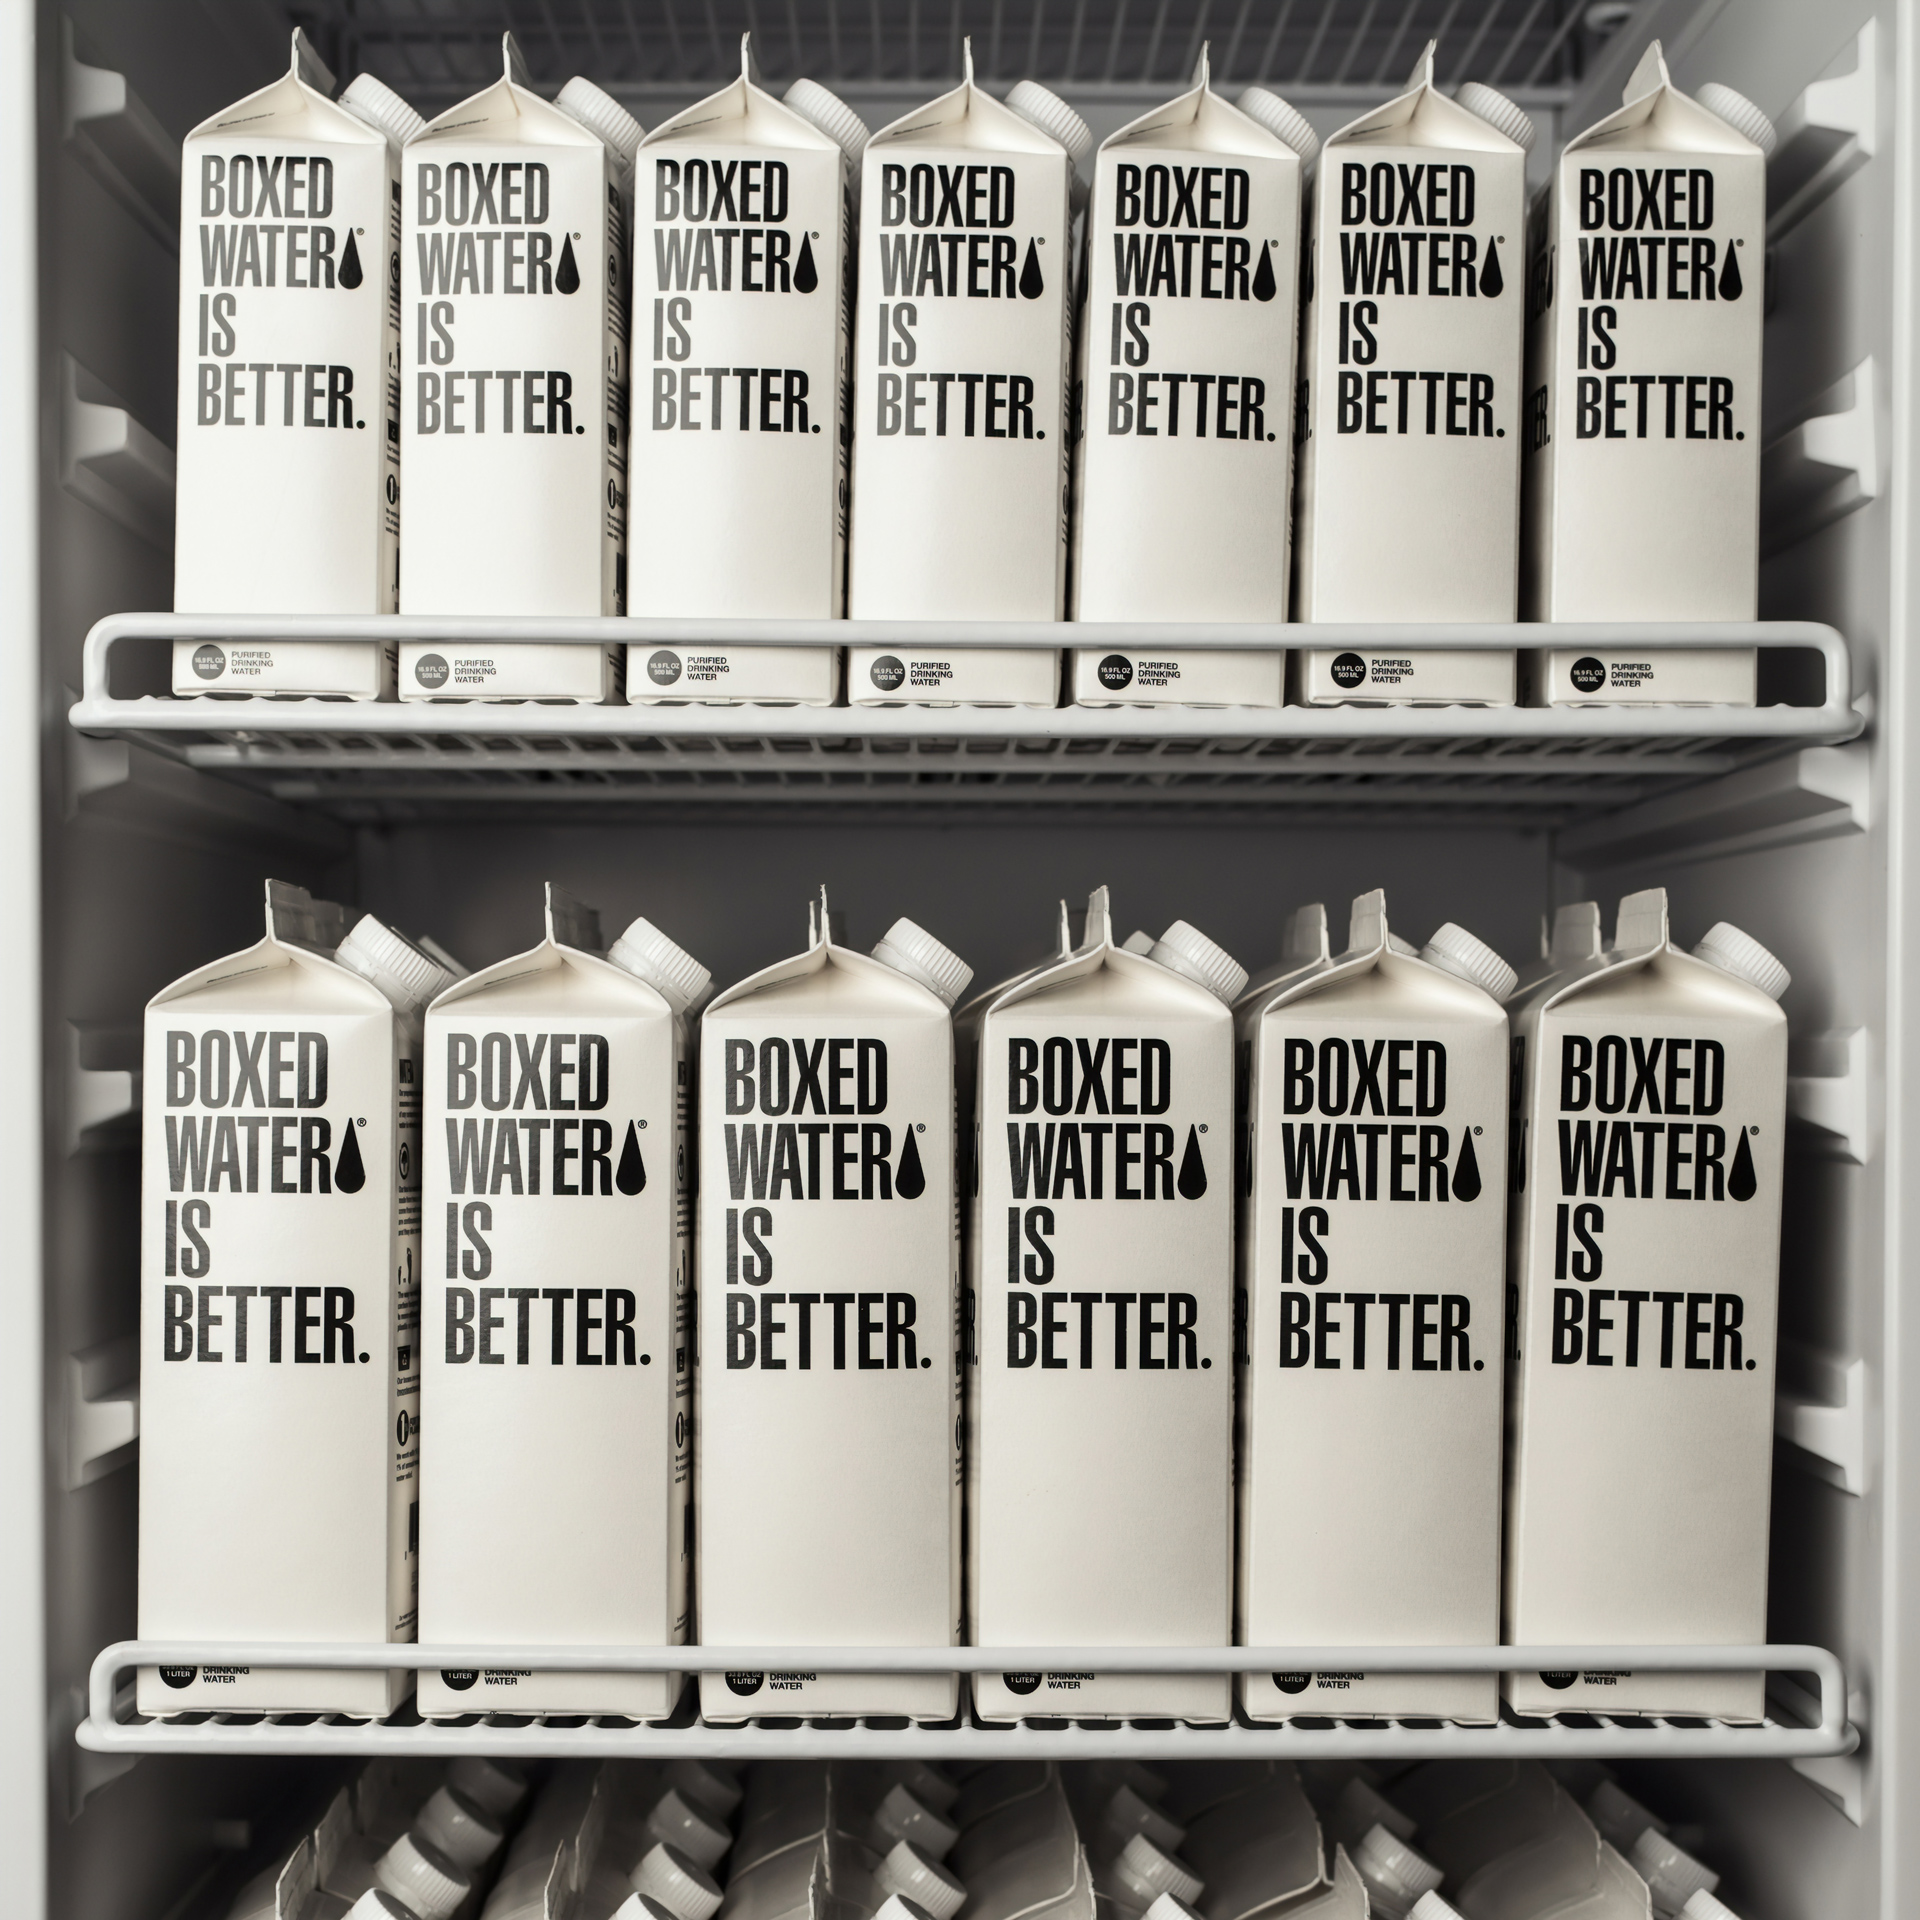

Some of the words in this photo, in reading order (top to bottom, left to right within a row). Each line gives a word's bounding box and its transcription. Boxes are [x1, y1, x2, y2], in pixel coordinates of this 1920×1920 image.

[202, 154, 333, 218] BOXED
[418, 162, 549, 225] BOXED
[656, 159, 788, 223] BOXED
[882, 163, 1015, 228] BOXED
[1116, 164, 1250, 230] BOXED
[1341, 162, 1475, 227] BOXED
[1579, 167, 1714, 232] BOXED
[200, 225, 335, 289] WATER
[417, 232, 553, 295] WATER
[654, 229, 791, 293] WATER
[880, 234, 1017, 299] WATER
[1114, 233, 1251, 301] WATER
[1340, 232, 1477, 298] WATER
[1578, 236, 1717, 301] WATER
[199, 293, 236, 357] IS
[418, 301, 454, 365] IS
[654, 297, 691, 361] IS
[879, 303, 917, 367] IS
[1111, 302, 1150, 367] IS
[1339, 300, 1378, 365] IS
[1578, 305, 1617, 371] IS
[198, 364, 365, 429] BETTER.
[418, 371, 585, 435] BETTER.
[653, 368, 821, 434] BETTER.
[877, 373, 1045, 440] BETTER.
[1108, 373, 1276, 442] BETTER.
[1337, 371, 1506, 438] BETTER.
[1576, 375, 1745, 441] BETTER.
[688, 665, 729, 673] DRINKING
[688, 673, 717, 681] WATER
[911, 670, 953, 678] DRINKING
[1139, 670, 1180, 678] DRINKING
[1139, 678, 1168, 686] WATER
[1372, 668, 1414, 676] DRINKING
[1372, 676, 1401, 684] WATER
[167, 1030, 328, 1108] BOXED
[447, 1032, 609, 1111] BOXED
[725, 1037, 888, 1116] BOXED
[1008, 1036, 1171, 1116] BOXED
[1283, 1037, 1447, 1117] BOXED
[1560, 1035, 1725, 1117] BOXED
[165, 1116, 332, 1194] WATER
[446, 1118, 613, 1196] WATER
[724, 1123, 893, 1200] WATER
[1007, 1123, 1175, 1200] WATER
[1281, 1123, 1449, 1202] WATER
[1558, 1119, 1727, 1202] WATER
[165, 1199, 210, 1278] IS
[446, 1202, 492, 1280] IS
[726, 1207, 772, 1286] IS
[1008, 1206, 1054, 1285] IS
[1281, 1206, 1329, 1285] IS
[1555, 1203, 1604, 1282] IS
[164, 1285, 370, 1363] BETTER.
[445, 1287, 651, 1365] BETTER.
[727, 1292, 932, 1370] BETTER.
[1007, 1292, 1212, 1370] BETTER.
[1279, 1291, 1484, 1371] BETTER.
[1551, 1288, 1756, 1370] BETTER.
[203, 1666, 249, 1675] DRINKING
[485, 1677, 518, 1685] WATER
[770, 1673, 816, 1681] DRINKING
[770, 1682, 803, 1690] WATER
[1048, 1681, 1080, 1689] WATER
[1317, 1681, 1350, 1689] WATER
[1584, 1677, 1617, 1685] WATER
